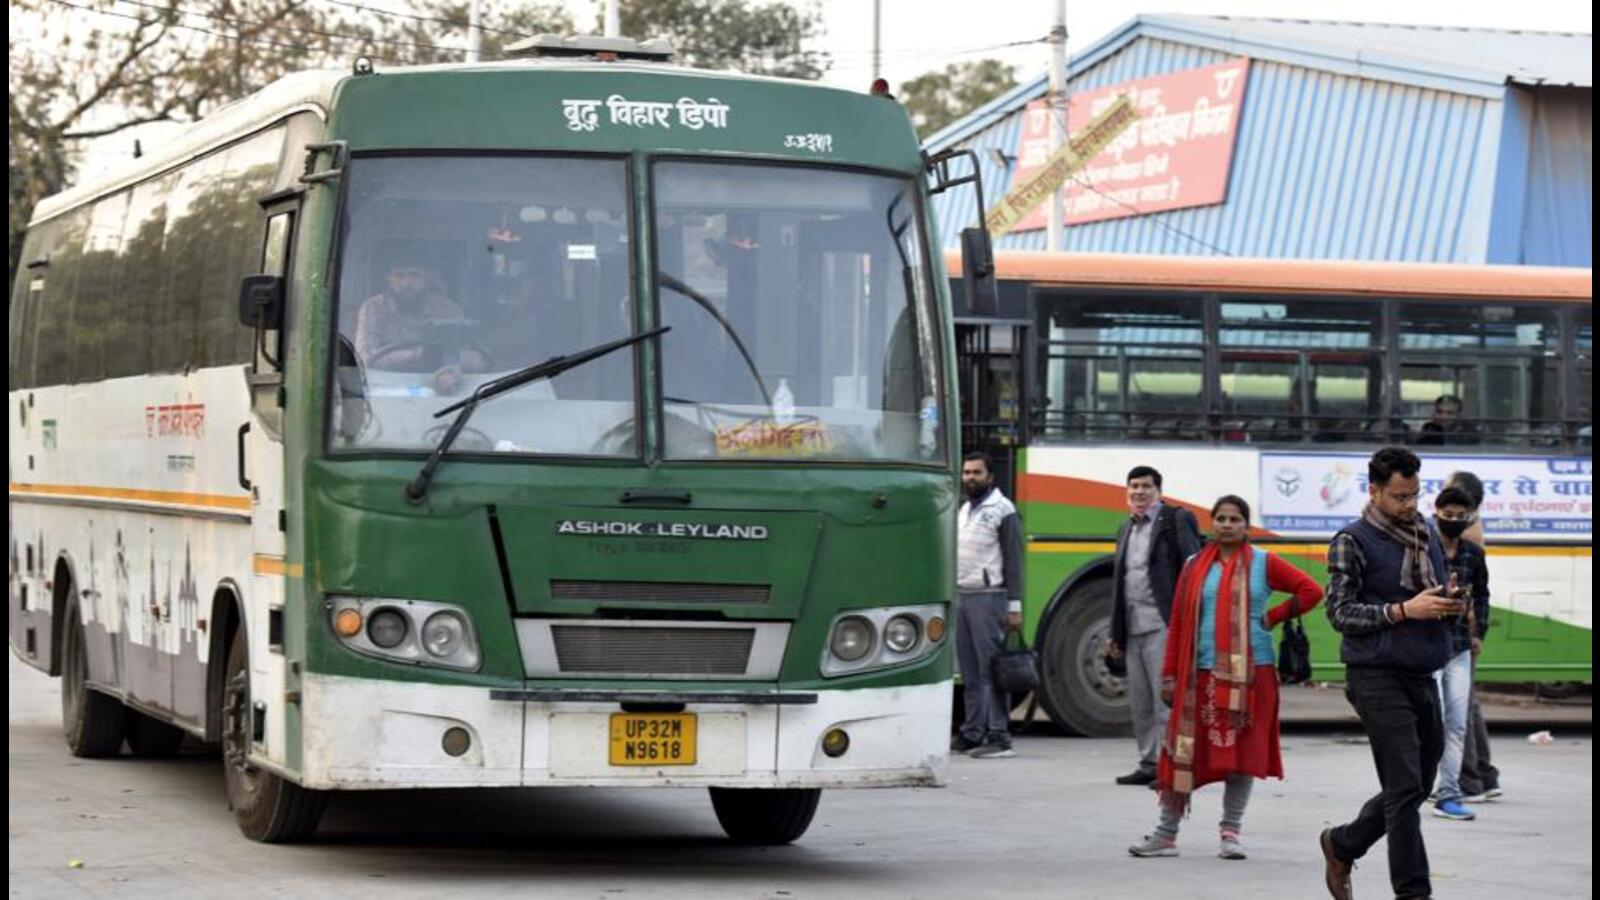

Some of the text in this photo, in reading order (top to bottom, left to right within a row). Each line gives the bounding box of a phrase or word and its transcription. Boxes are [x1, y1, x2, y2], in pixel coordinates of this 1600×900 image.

[606, 94, 673, 128] विहार
[676, 97, 730, 130] डिपो
[1513, 475, 1541, 496] से
[558, 519, 769, 540] ASHOK LEYLAND
[624, 740, 682, 760] N9618
